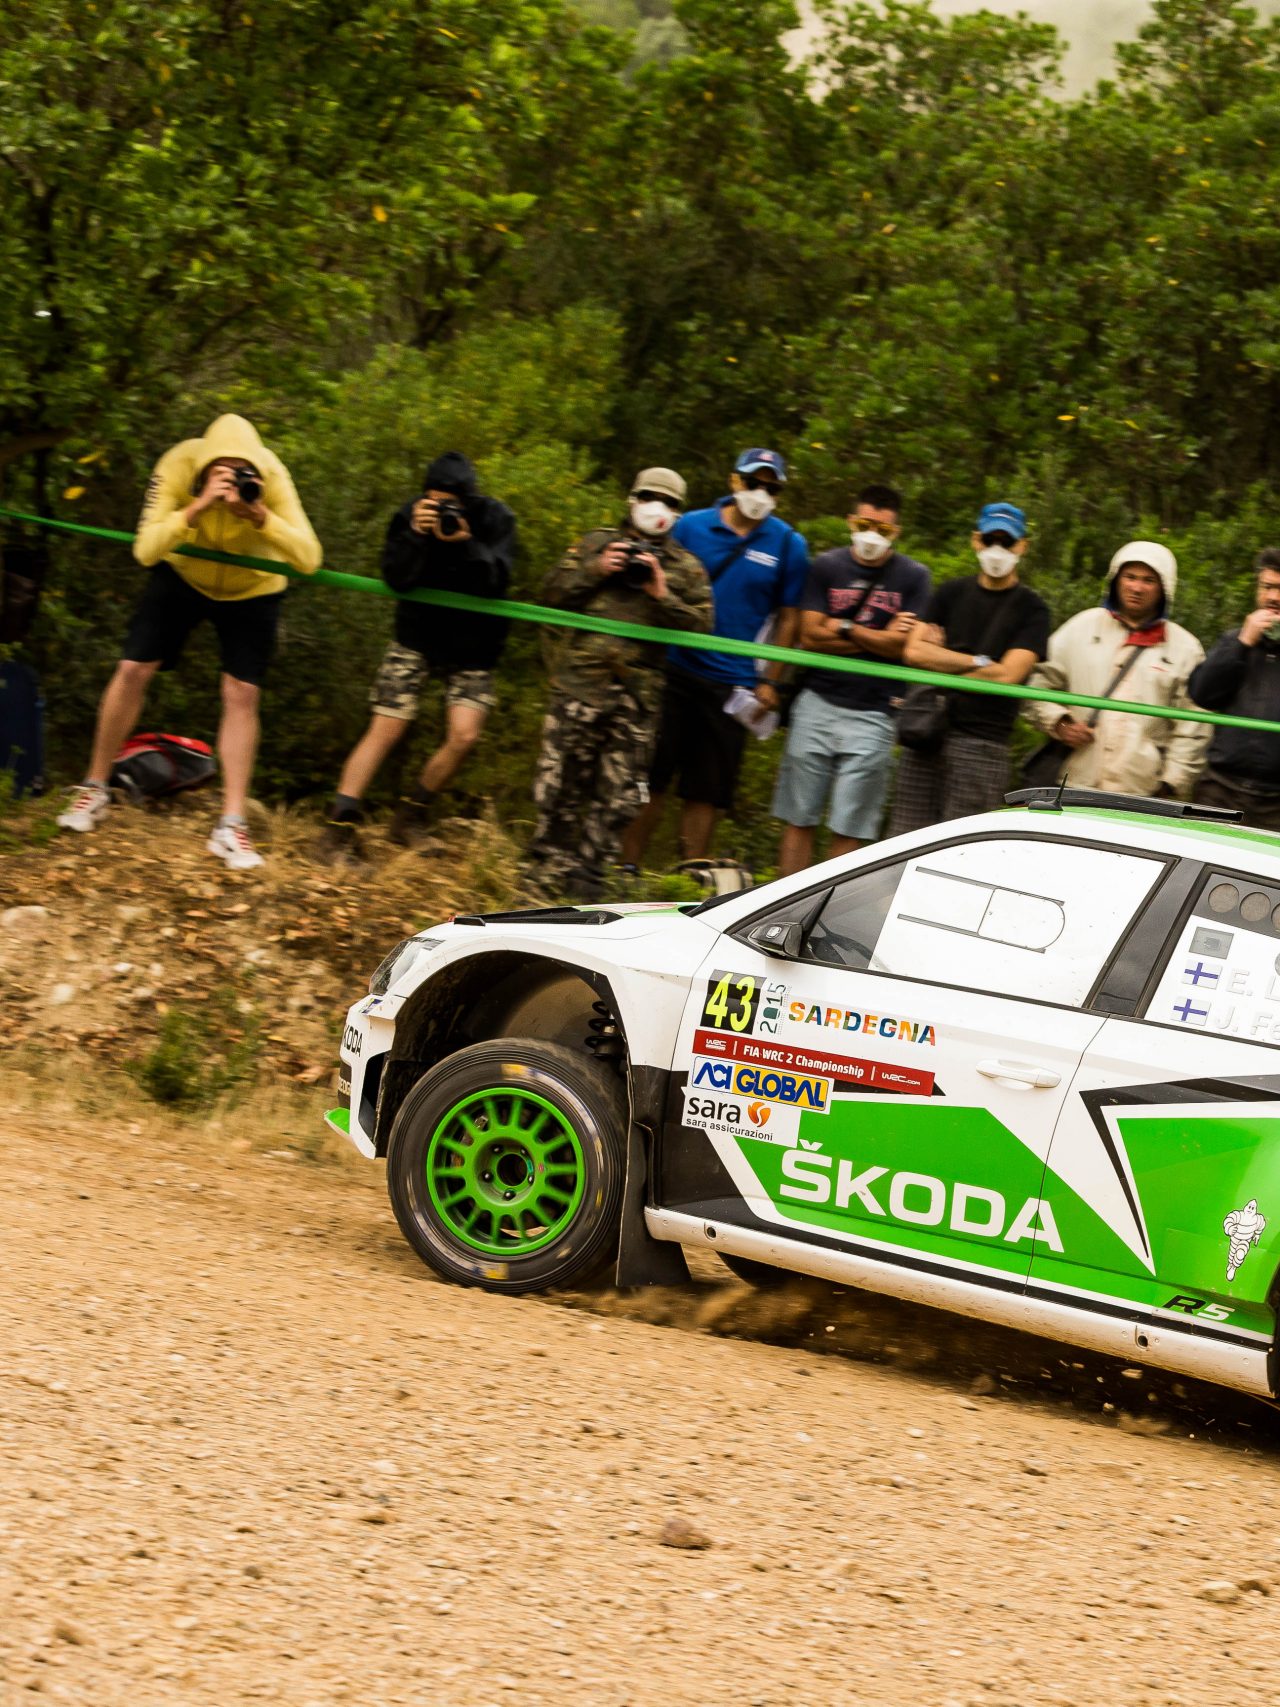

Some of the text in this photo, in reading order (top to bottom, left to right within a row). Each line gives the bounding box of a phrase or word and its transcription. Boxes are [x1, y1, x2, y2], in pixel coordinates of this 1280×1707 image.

[1226, 968, 1254, 996] E.
[705, 972, 756, 1032] 43
[759, 983, 787, 1034] 2015
[788, 1001, 936, 1046] SARDEGNA
[1215, 1006, 1239, 1032] J.
[743, 1045, 864, 1078] FIA WRC 2 Championship
[693, 1061, 825, 1108] ACI GLOBAL
[687, 1096, 741, 1124] sara
[686, 1118, 774, 1142] sara assicurazioni
[779, 1138, 1065, 1254] ŠKODA
[1163, 1295, 1236, 1321] R5
